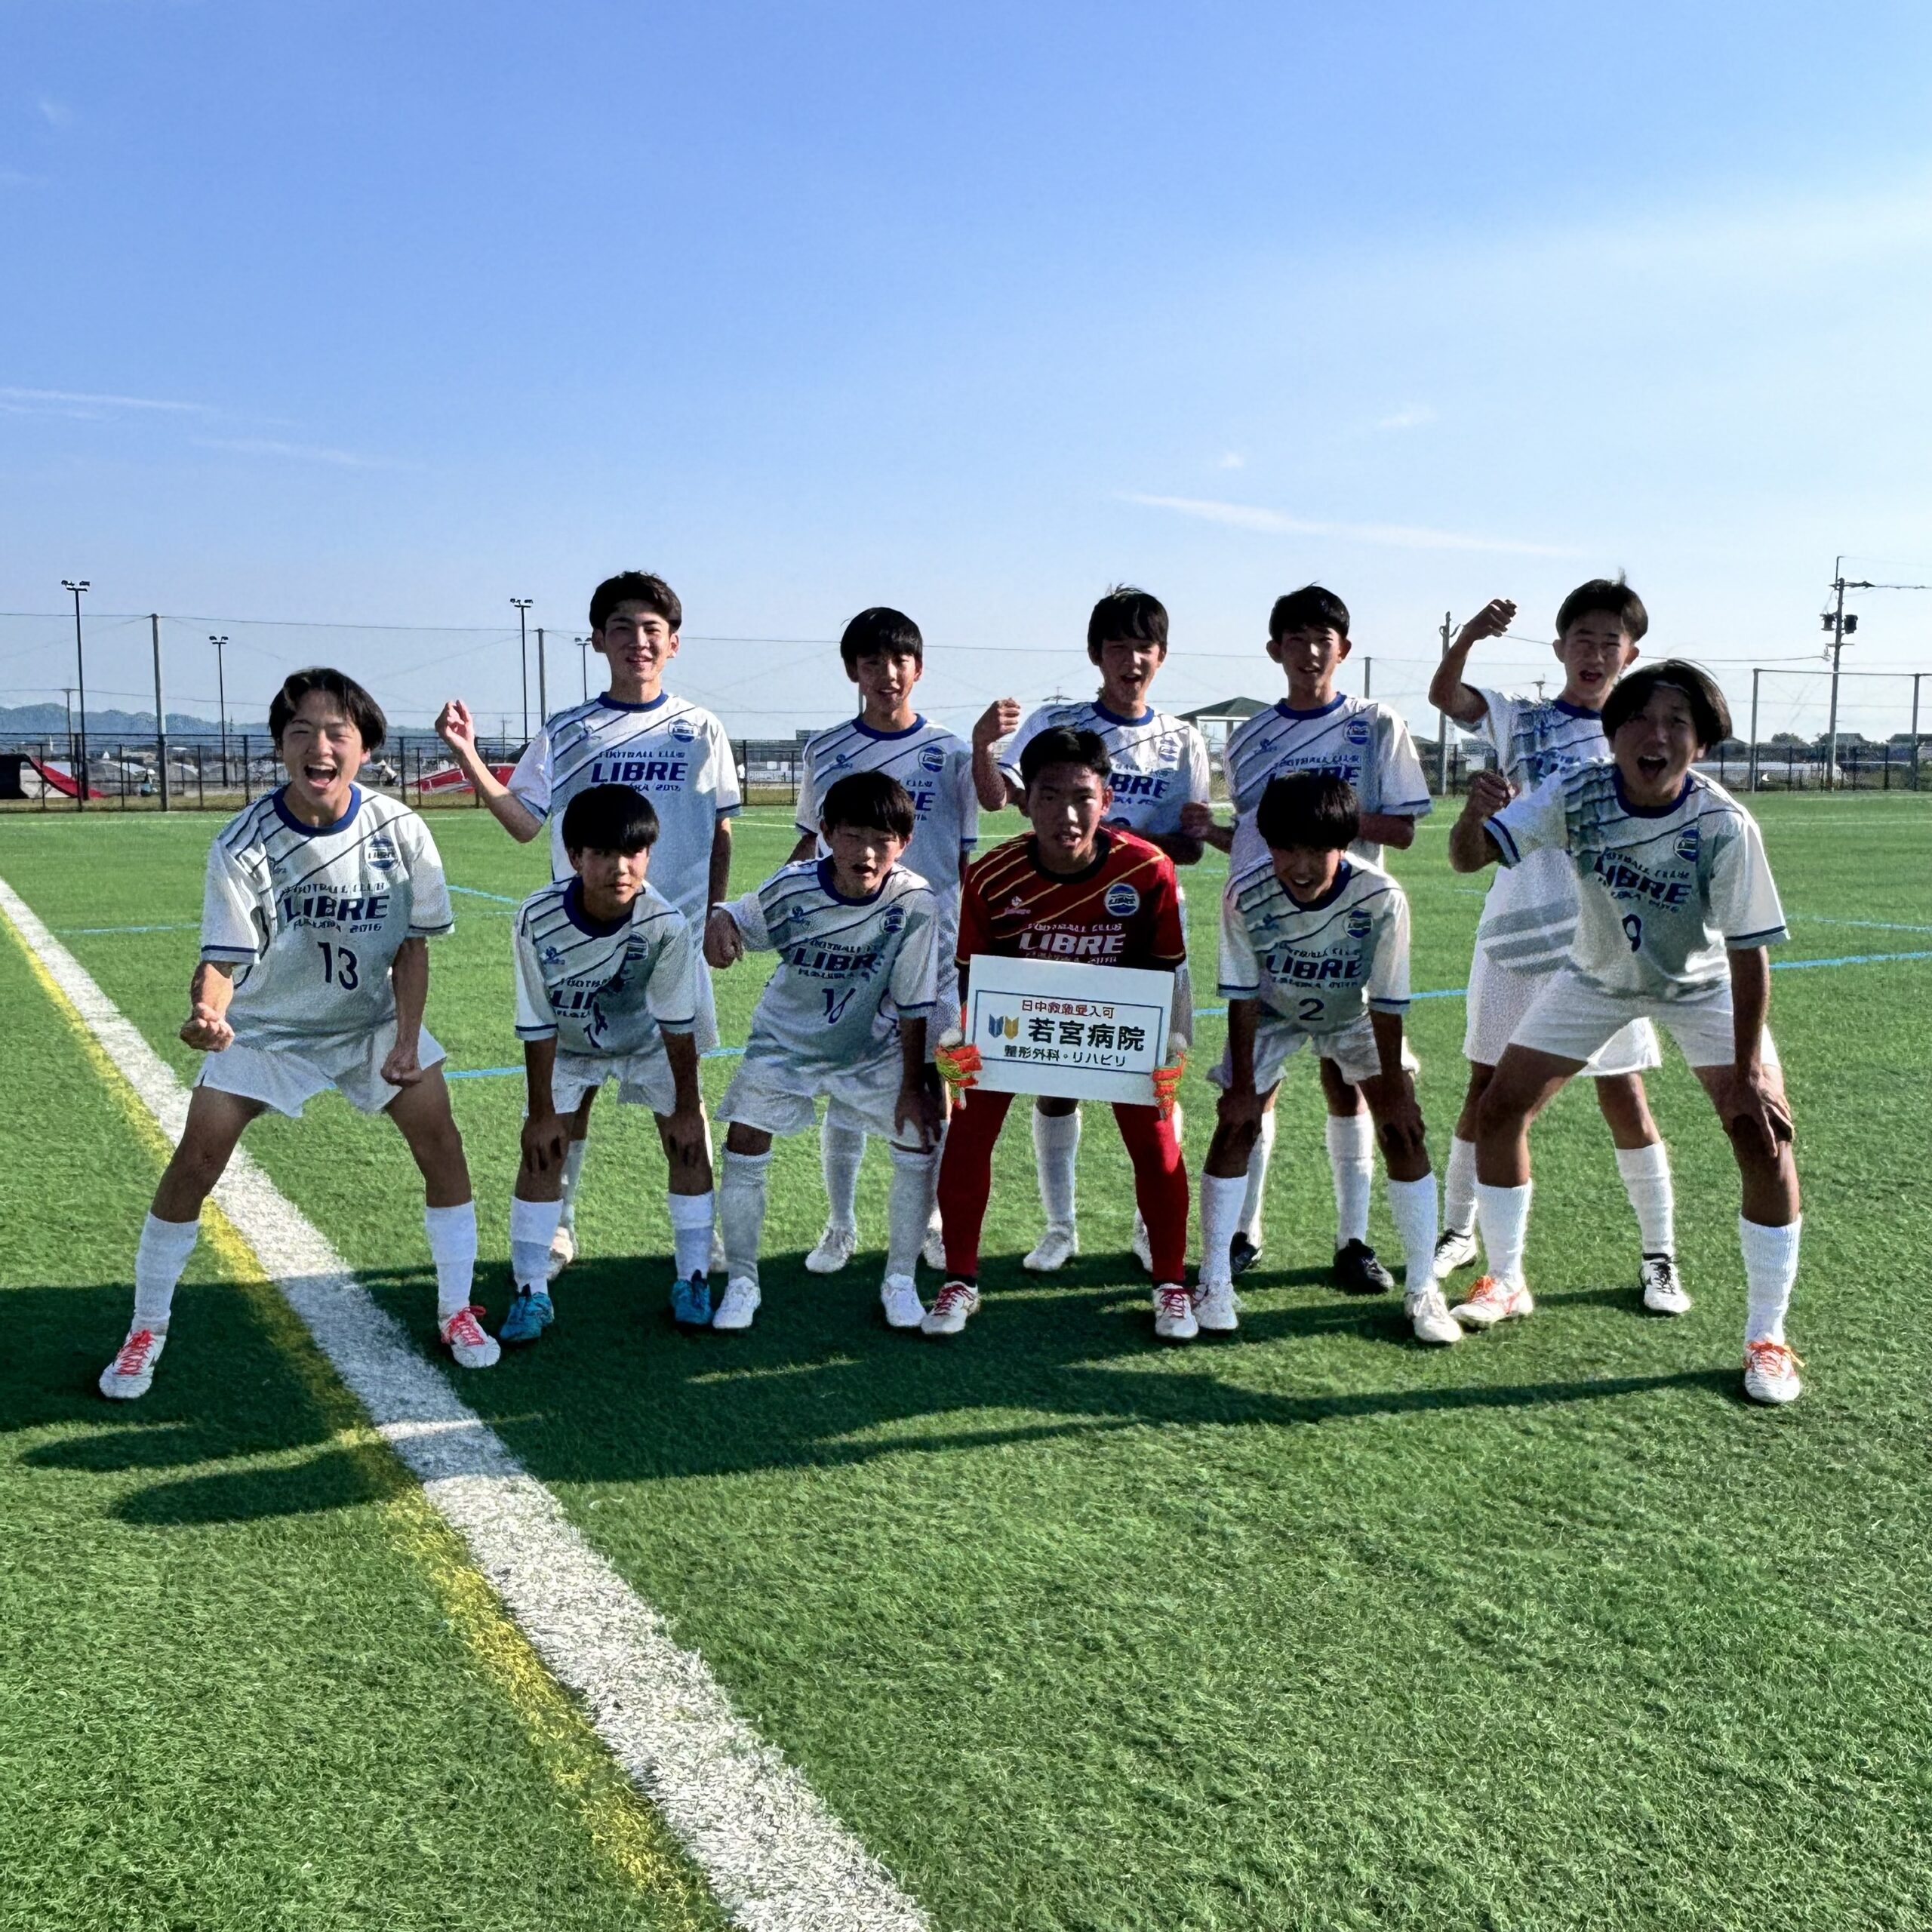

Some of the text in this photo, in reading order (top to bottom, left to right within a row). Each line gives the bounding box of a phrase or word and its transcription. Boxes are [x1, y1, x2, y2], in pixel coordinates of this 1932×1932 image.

[591, 761, 689, 783] LIBRE
[1109, 773, 1171, 799] BRE
[283, 895, 390, 922] LIBRE
[1019, 932, 1127, 955] LIBRE
[1622, 914, 1642, 952] 9
[317, 941, 358, 991] 13
[1266, 954, 1362, 980] LIBRE
[1298, 998, 1324, 1021] 2
[1027, 1017, 1146, 1052] 若宮病院
